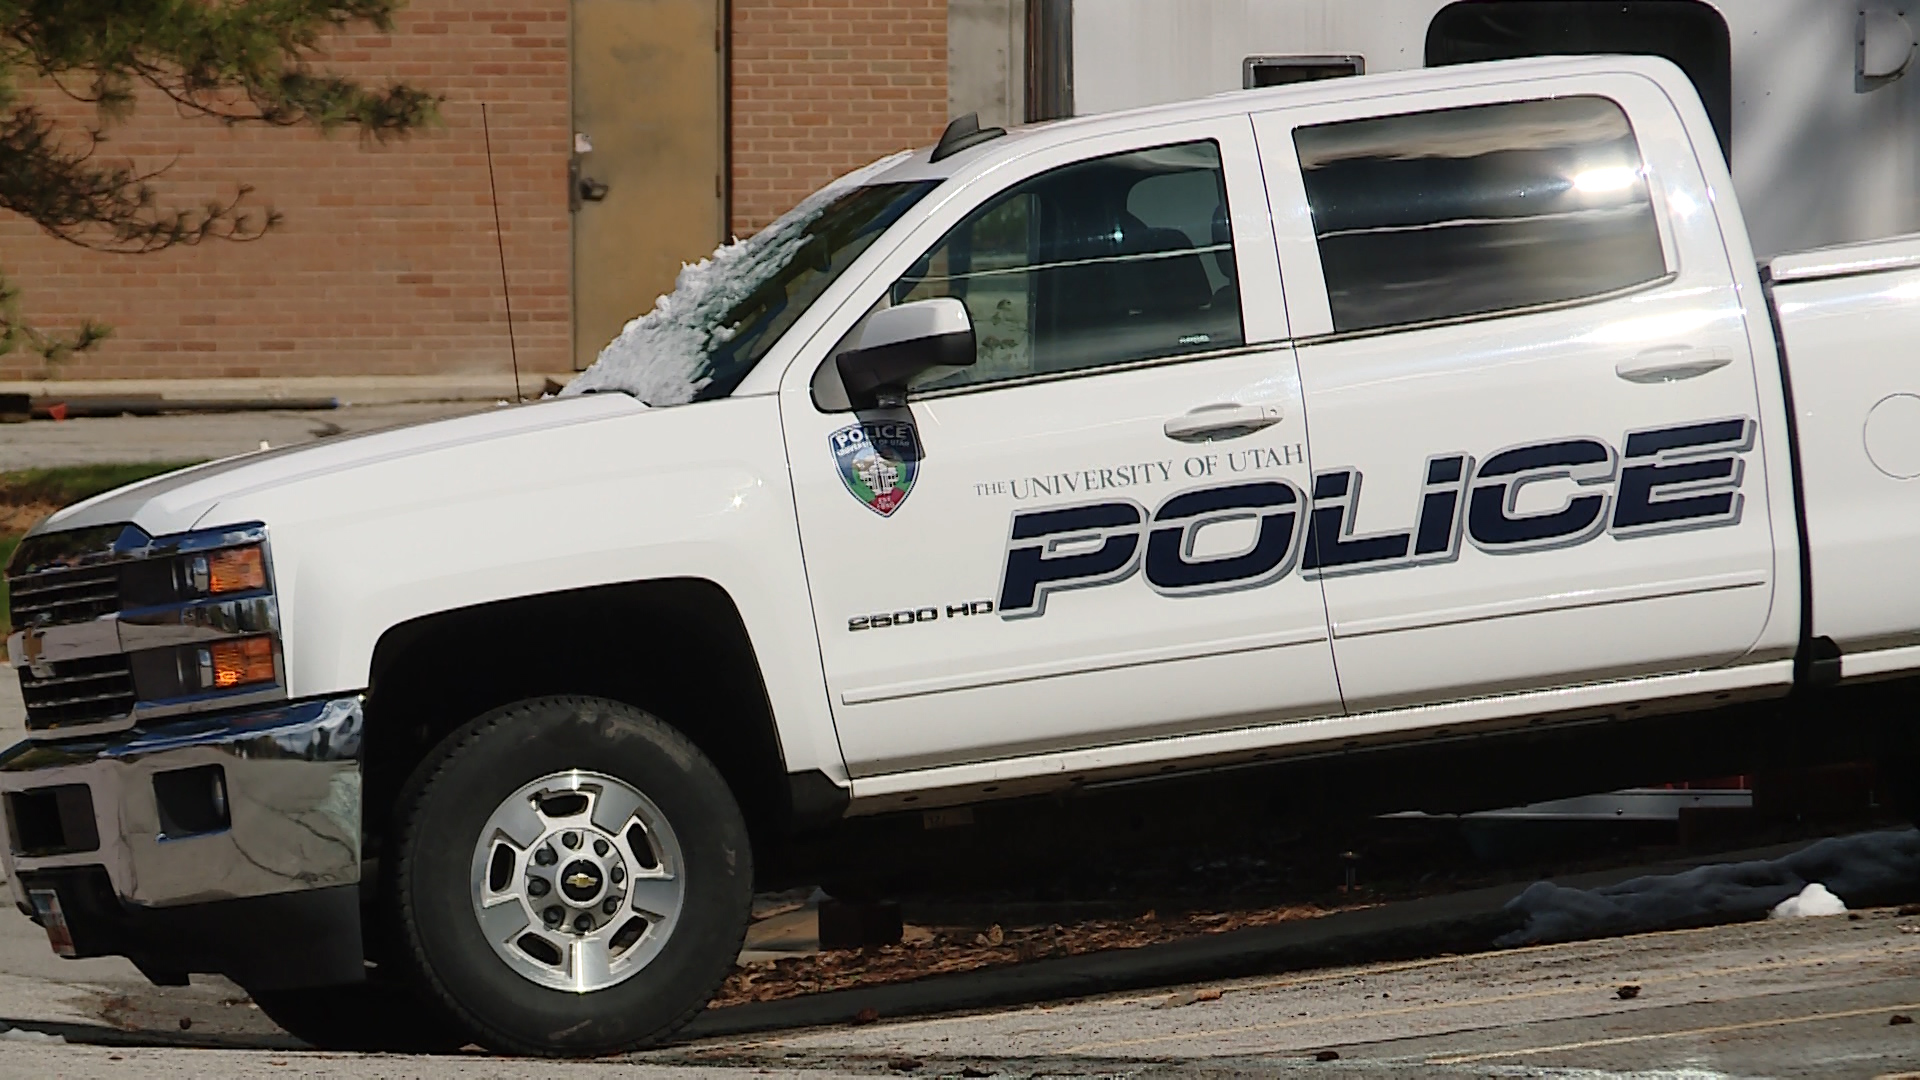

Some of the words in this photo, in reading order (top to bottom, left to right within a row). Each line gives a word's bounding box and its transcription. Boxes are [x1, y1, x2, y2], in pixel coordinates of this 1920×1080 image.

[835, 424, 908, 449] POLICE
[973, 481, 1007, 497] THE
[1009, 459, 1174, 500] UNIVERSITY
[1183, 454, 1219, 478] OF
[1227, 443, 1304, 472] UTAH
[998, 414, 1756, 620] POLICE
[848, 606, 938, 632] 2500
[946, 600, 994, 619] HD
